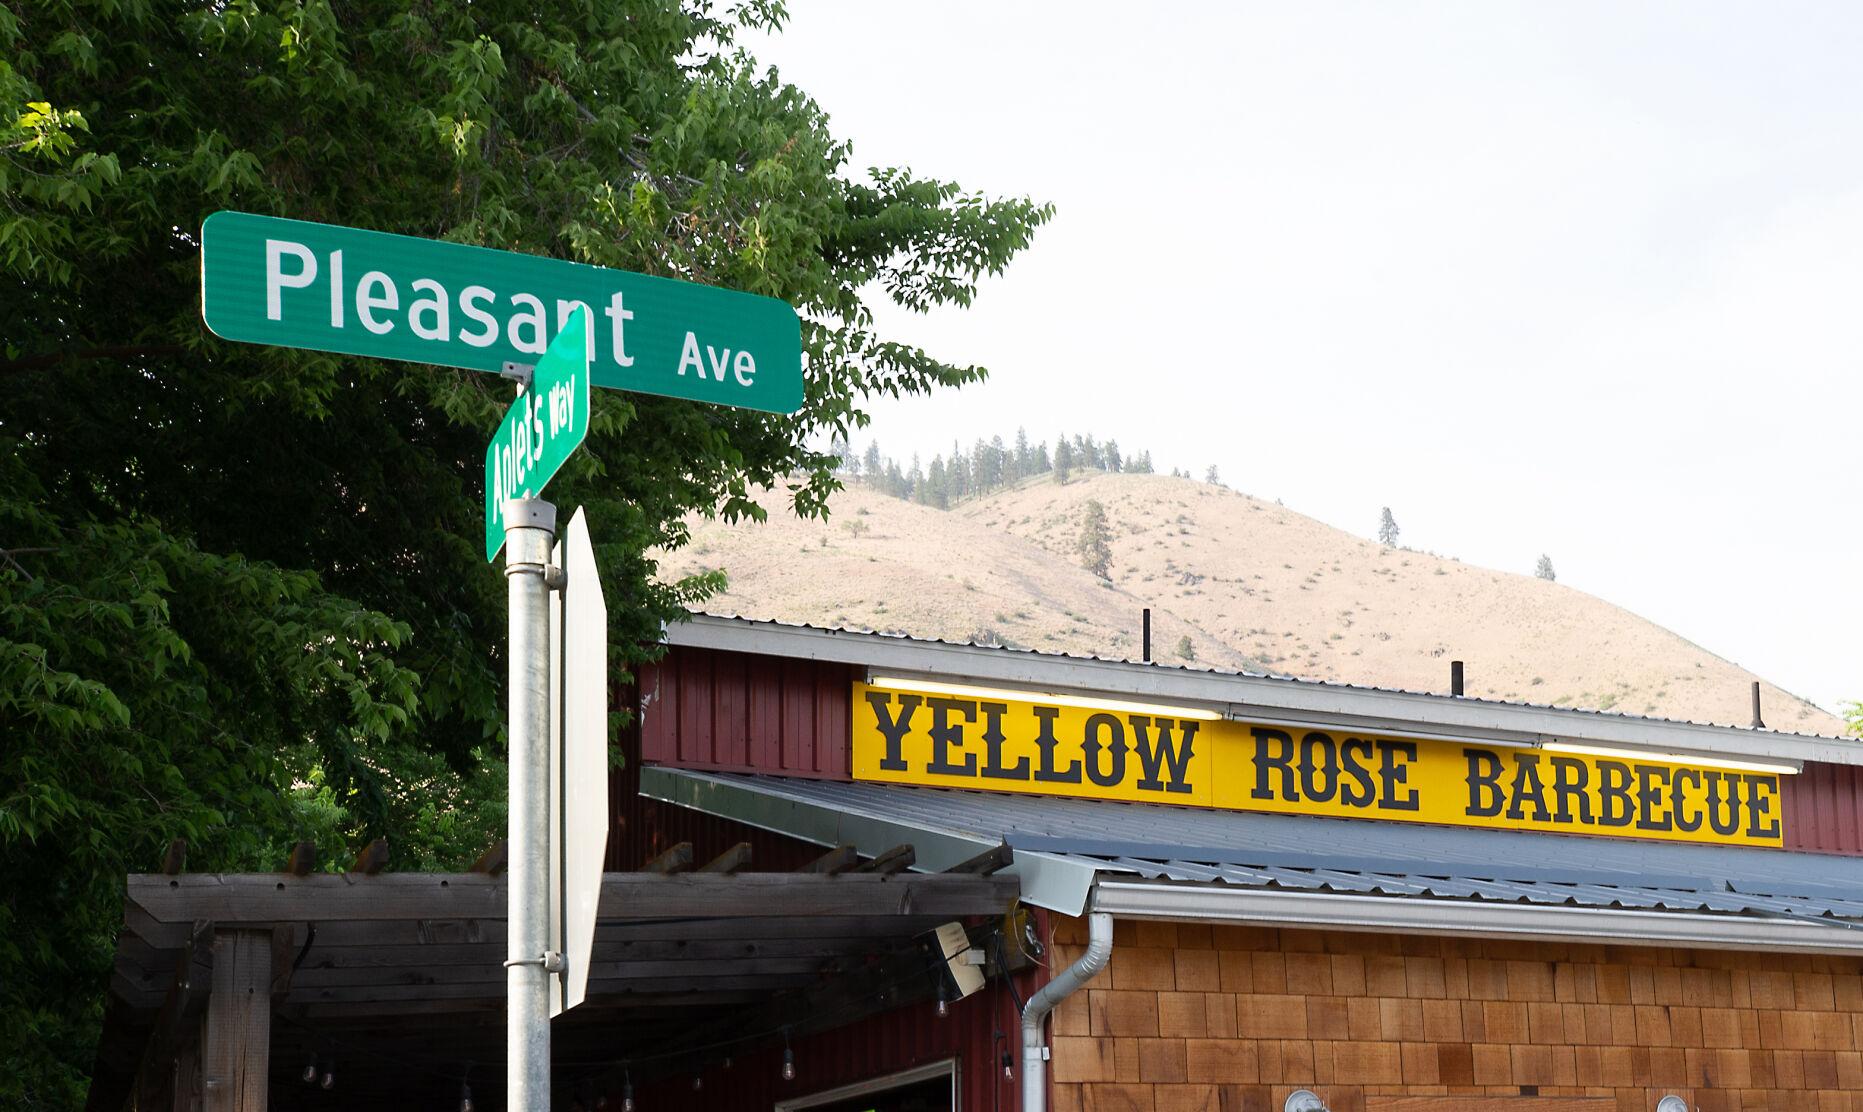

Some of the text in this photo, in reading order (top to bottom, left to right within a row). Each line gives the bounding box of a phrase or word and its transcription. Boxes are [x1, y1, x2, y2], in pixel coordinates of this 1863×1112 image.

[265, 239, 756, 387] Pleasant Ave
[549, 373, 575, 440] Way
[865, 692, 1780, 838] YELLOW ROSE BARBECUE
